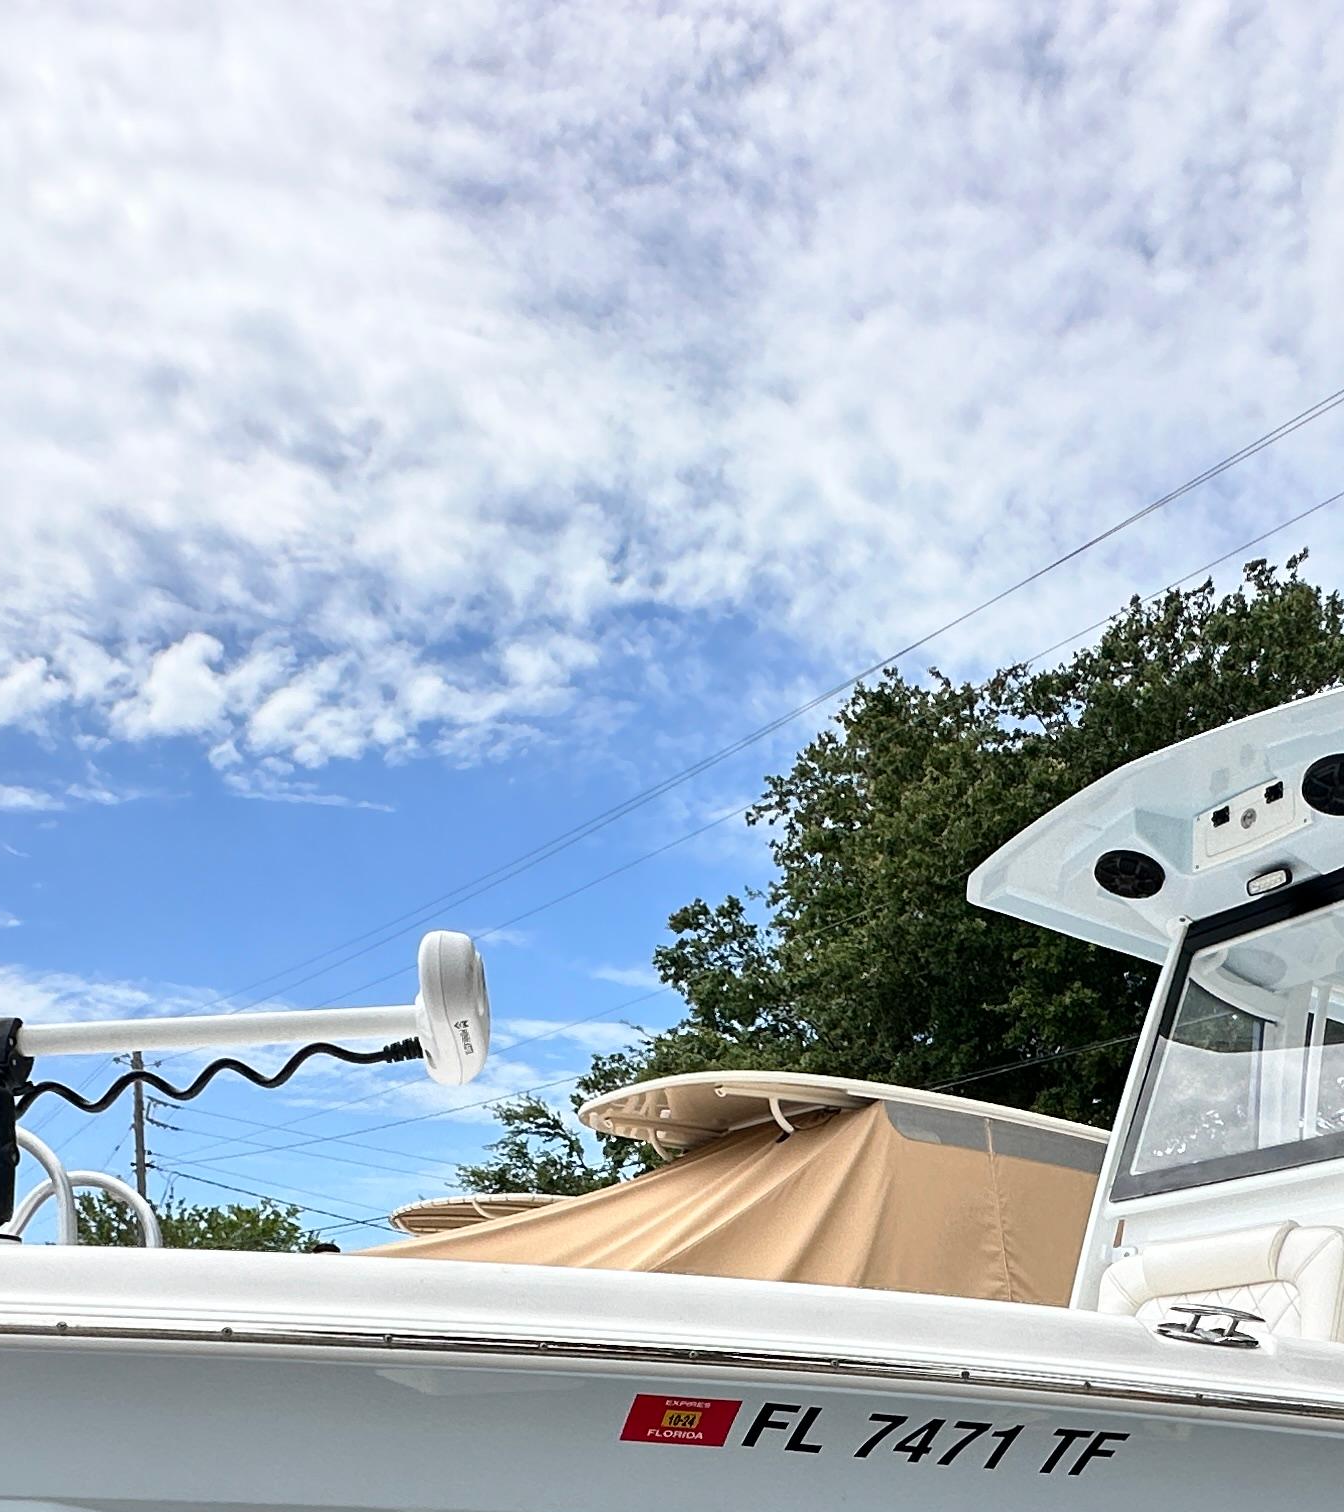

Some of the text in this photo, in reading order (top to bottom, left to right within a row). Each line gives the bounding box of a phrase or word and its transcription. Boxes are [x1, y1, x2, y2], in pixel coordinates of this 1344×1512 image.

[665, 1399, 711, 1409] EXPIRES
[646, 1428, 704, 1440] FLORIDA
[741, 1402, 1131, 1476] FL 7471 TF
